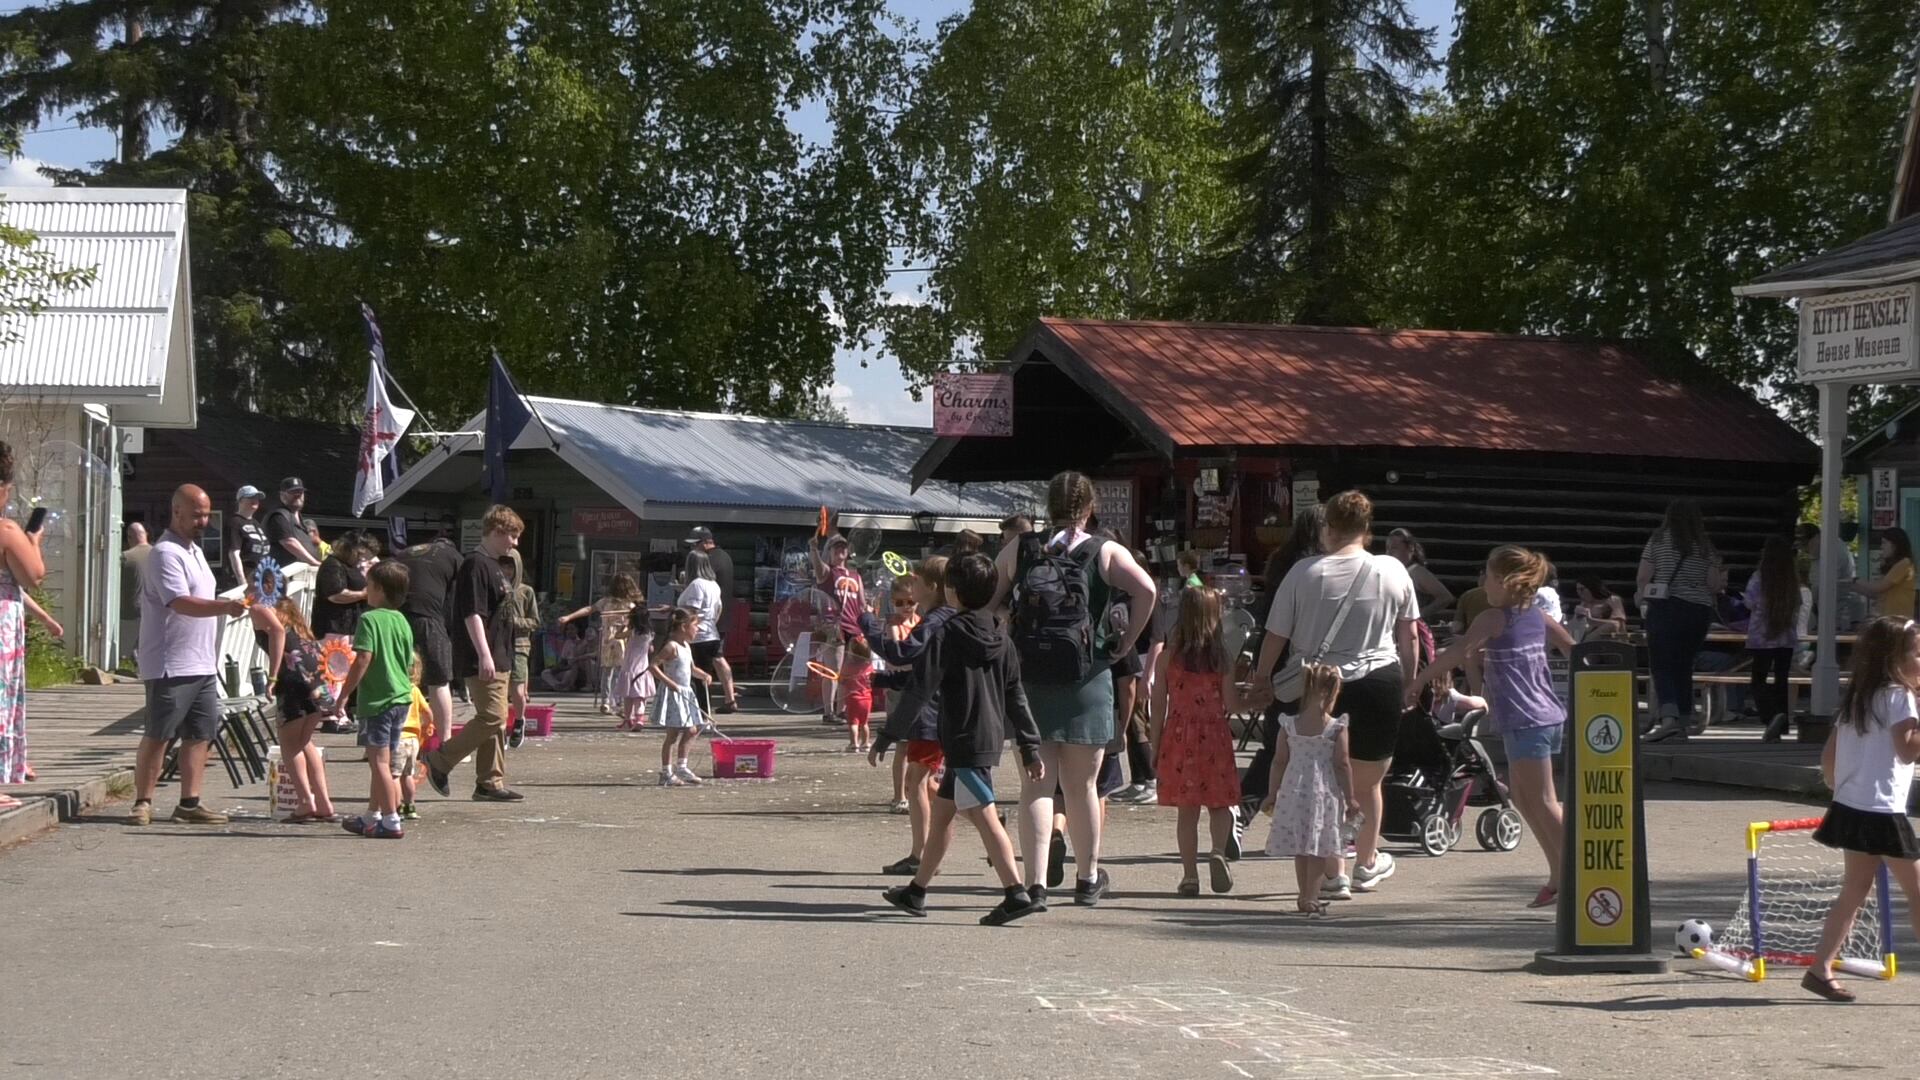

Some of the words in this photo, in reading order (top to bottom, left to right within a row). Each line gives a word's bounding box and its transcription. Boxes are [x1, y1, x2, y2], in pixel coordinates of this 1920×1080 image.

[1812, 305, 1852, 335] KITTY
[1853, 296, 1910, 330] HENSLEY
[1816, 341, 1850, 363] House
[1854, 336, 1900, 358] Museum
[940, 391, 1008, 409] Charms
[951, 412, 962, 422] by
[1876, 490, 1892, 507] GIFT
[1589, 688, 1618, 698] Please
[1584, 771, 1624, 794] WALK
[1584, 804, 1624, 830] YOUR
[1584, 840, 1624, 870] BIKE
